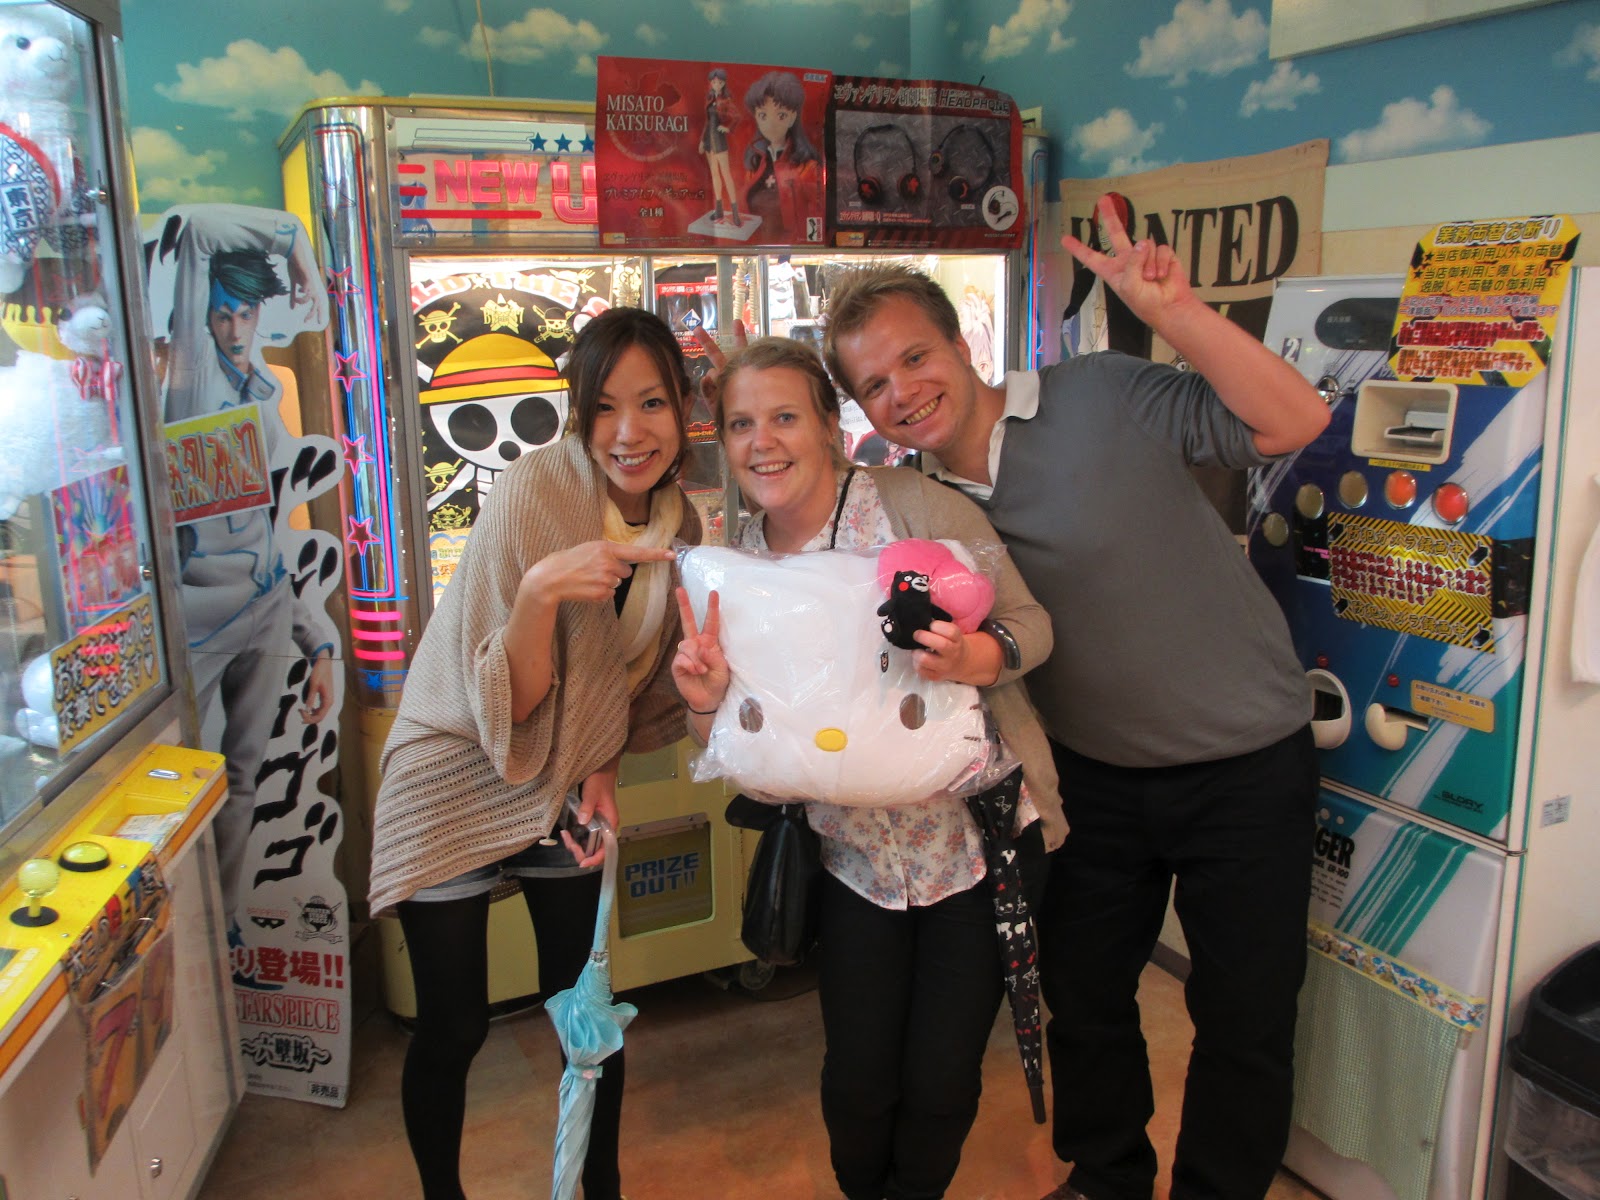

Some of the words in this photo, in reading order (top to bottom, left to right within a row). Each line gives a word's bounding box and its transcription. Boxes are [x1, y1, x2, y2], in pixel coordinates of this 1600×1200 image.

[606, 93, 665, 112] MISATO
[605, 113, 690, 133] KATSURAGI
[434, 159, 540, 204] NEW
[1436, 219, 1561, 245] 業務両替お断り
[1346, 523, 1466, 563] 防犯カメラ録画中
[1350, 600, 1467, 640] 防犯カメラ録画中
[1314, 827, 1355, 869] GER
[624, 851, 700, 883] PRIZE
[629, 870, 698, 898] OUT!!
[237, 992, 284, 1026] TARS
[286, 996, 338, 1032] PIECE
[310, 1083, 339, 1098] 非売品
